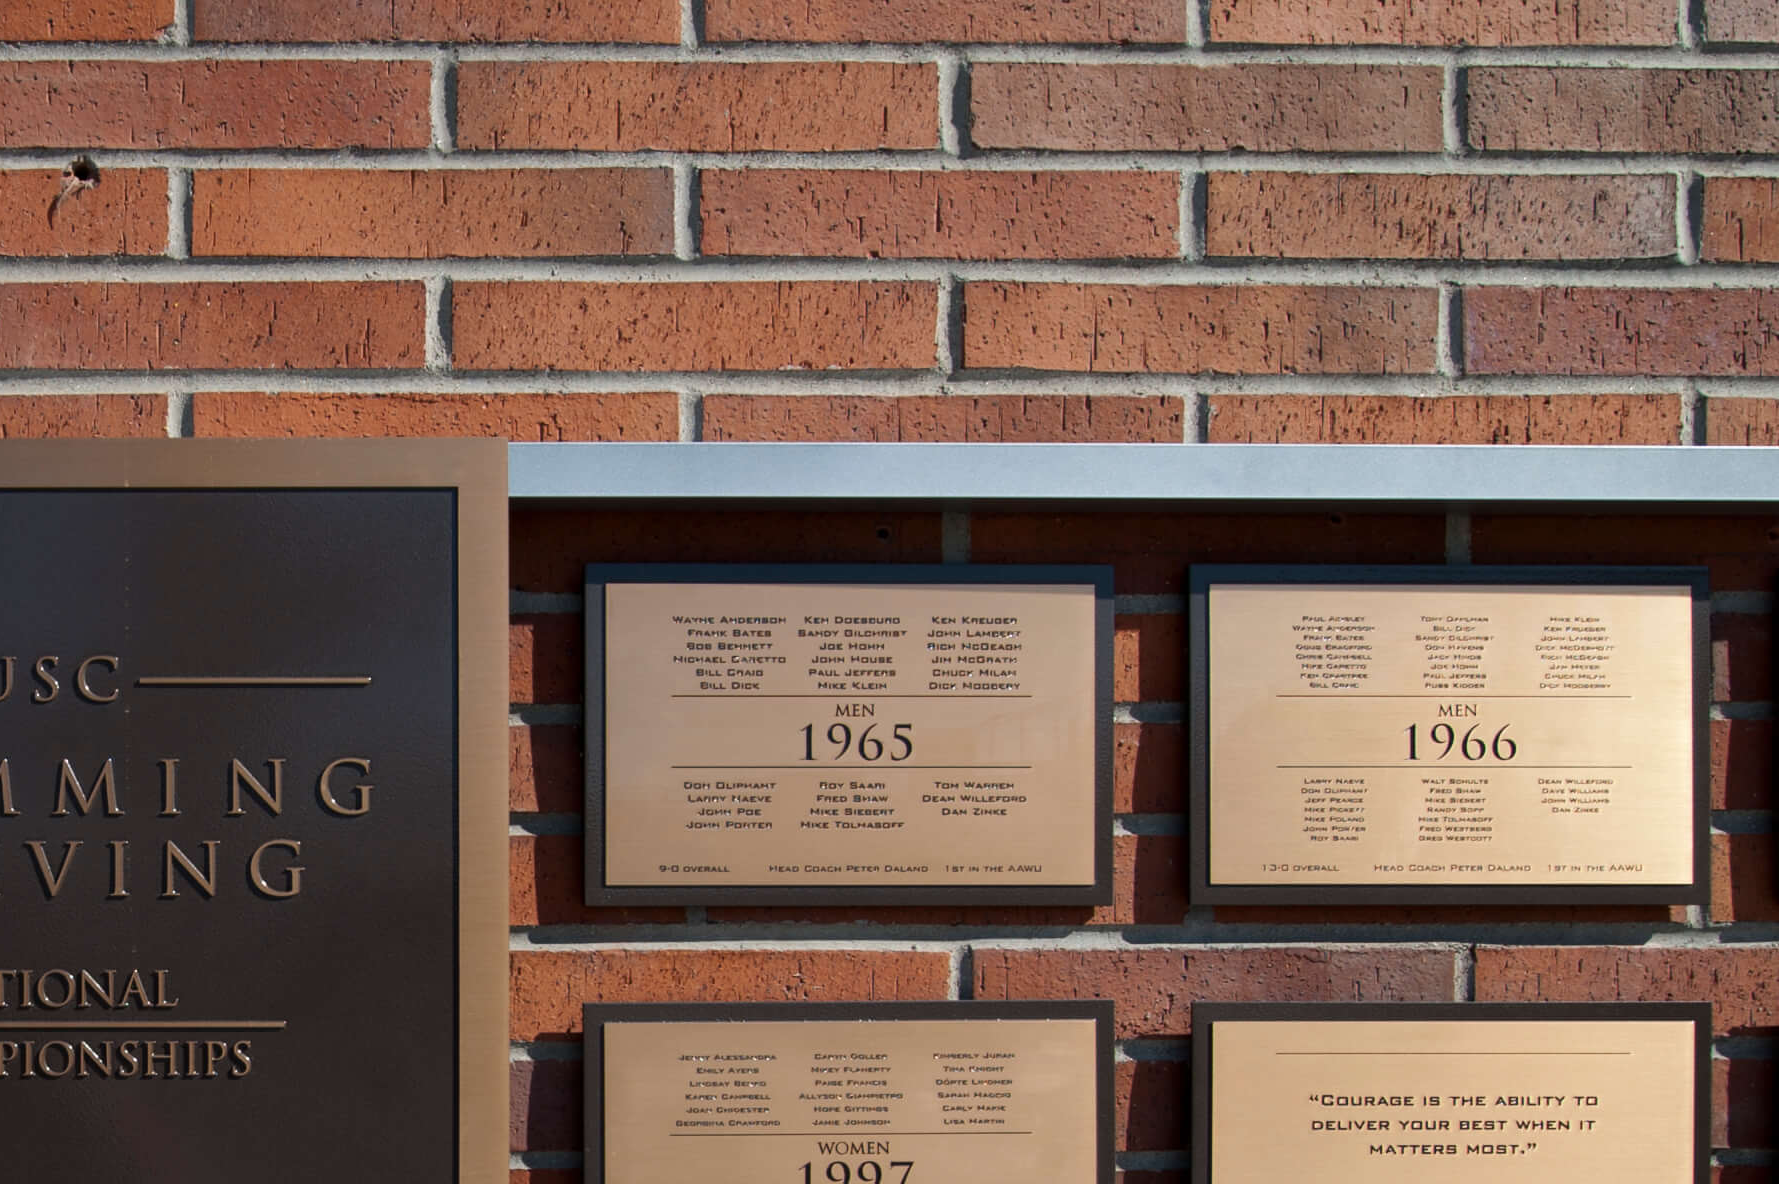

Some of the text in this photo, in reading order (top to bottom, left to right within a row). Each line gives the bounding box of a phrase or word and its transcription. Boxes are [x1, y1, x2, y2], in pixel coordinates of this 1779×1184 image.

[835, 703, 875, 718] MEN
[1438, 703, 1477, 718] MEN
[800, 722, 913, 762] 1965
[1407, 723, 1517, 761] 1966
[1422, 1095, 1441, 1107] IS
[1448, 1095, 1487, 1107] THE
[1494, 1095, 1565, 1107] ABILITY
[1572, 1095, 1598, 1107] TO
[1311, 1119, 1597, 1131] DELIVER YOUR BEST WHEN IT
[817, 1140, 890, 1156] WOMEN
[1369, 1144, 1458, 1156] MATTERS
